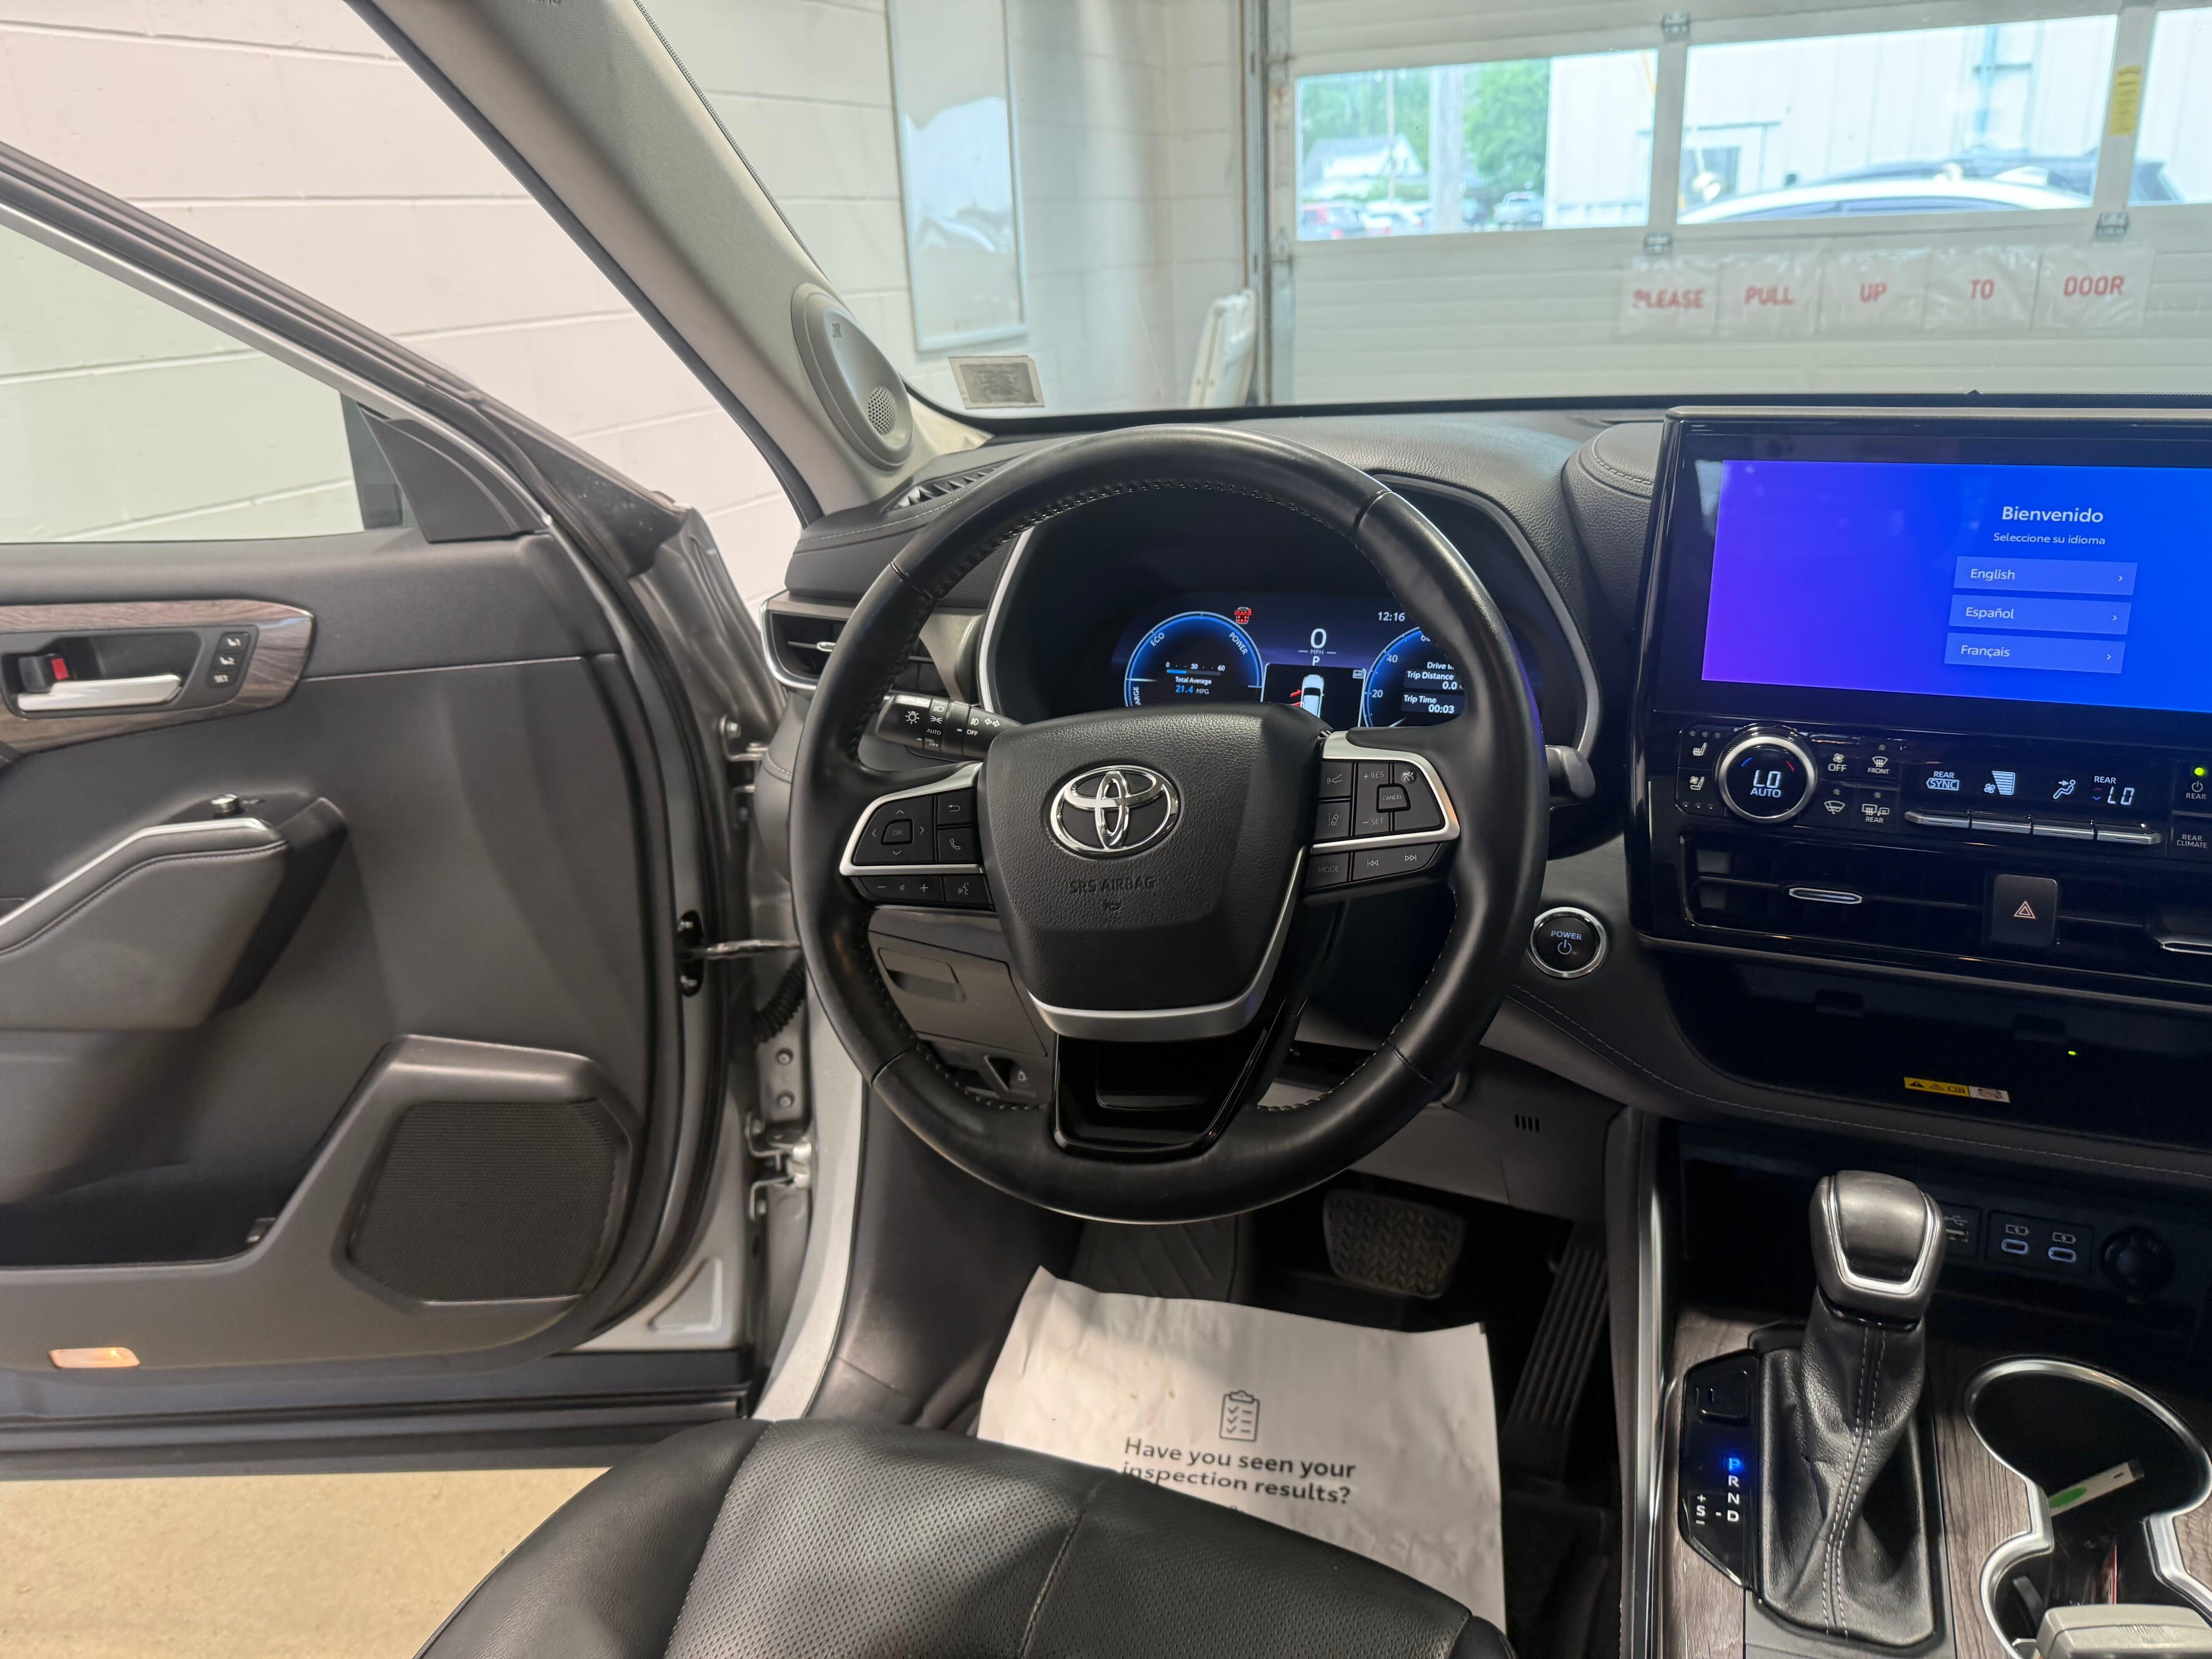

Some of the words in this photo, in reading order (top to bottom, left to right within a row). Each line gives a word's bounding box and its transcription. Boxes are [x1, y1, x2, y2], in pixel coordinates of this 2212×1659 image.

[1632, 289, 1705, 309] PLEASE
[1744, 286, 1795, 306] PULL
[1860, 282, 1887, 302] UP
[1970, 279, 1995, 300] TO
[2063, 276, 2125, 297] DOOR
[2002, 506, 2104, 523] Bienvenido
[1993, 532, 2051, 543] Seleccione
[2052, 536, 2065, 544] su
[2068, 534, 2106, 545] idioma
[1970, 568, 2015, 581] English
[1377, 611, 1405, 622] 12:16
[1965, 606, 2014, 620] Español
[1150, 632, 1165, 647] ECO
[1228, 632, 1248, 655] POWER
[1310, 628, 1327, 649] 0
[1960, 644, 2010, 658] Français
[1312, 656, 1320, 666] P
[1387, 654, 1398, 663] 40
[1427, 661, 1446, 670] Drive
[1407, 670, 1421, 680] Trip
[1422, 671, 1454, 680] Distance
[1189, 677, 1212, 686] Average
[1442, 681, 1458, 690] 0.0
[1175, 684, 1194, 694] 21.4
[1372, 689, 1383, 698] 20
[1133, 686, 1141, 706] ARGE
[1403, 694, 1418, 704] Trip
[1419, 695, 1437, 704] Time
[1428, 704, 1455, 714] 00:03
[1827, 763, 1847, 772] OFF
[1753, 769, 1781, 788] LO
[2094, 776, 2116, 785] REAR
[1930, 779, 1957, 790] SYNC
[1750, 787, 1781, 798] AUTO
[2107, 786, 2135, 805] LO
[2182, 834, 2203, 842] REAR
[2176, 839, 2208, 849] CLIMATE
[1069, 880, 1097, 893] SRS
[1103, 876, 1157, 891] AIRBAG
[1551, 930, 1583, 940] POWER
[1124, 1436, 1182, 1460] Have
[1188, 1450, 1231, 1467] you
[1238, 1454, 1293, 1473] seen
[1300, 1460, 1357, 1479] your
[1729, 1457, 1741, 1469] P
[1123, 1462, 1248, 1490] inspection
[1255, 1482, 1351, 1504] results?
[1728, 1475, 1739, 1487] R
[1728, 1492, 1740, 1505] N
[1696, 1505, 1705, 1516] S
[1727, 1510, 1739, 1522] D
